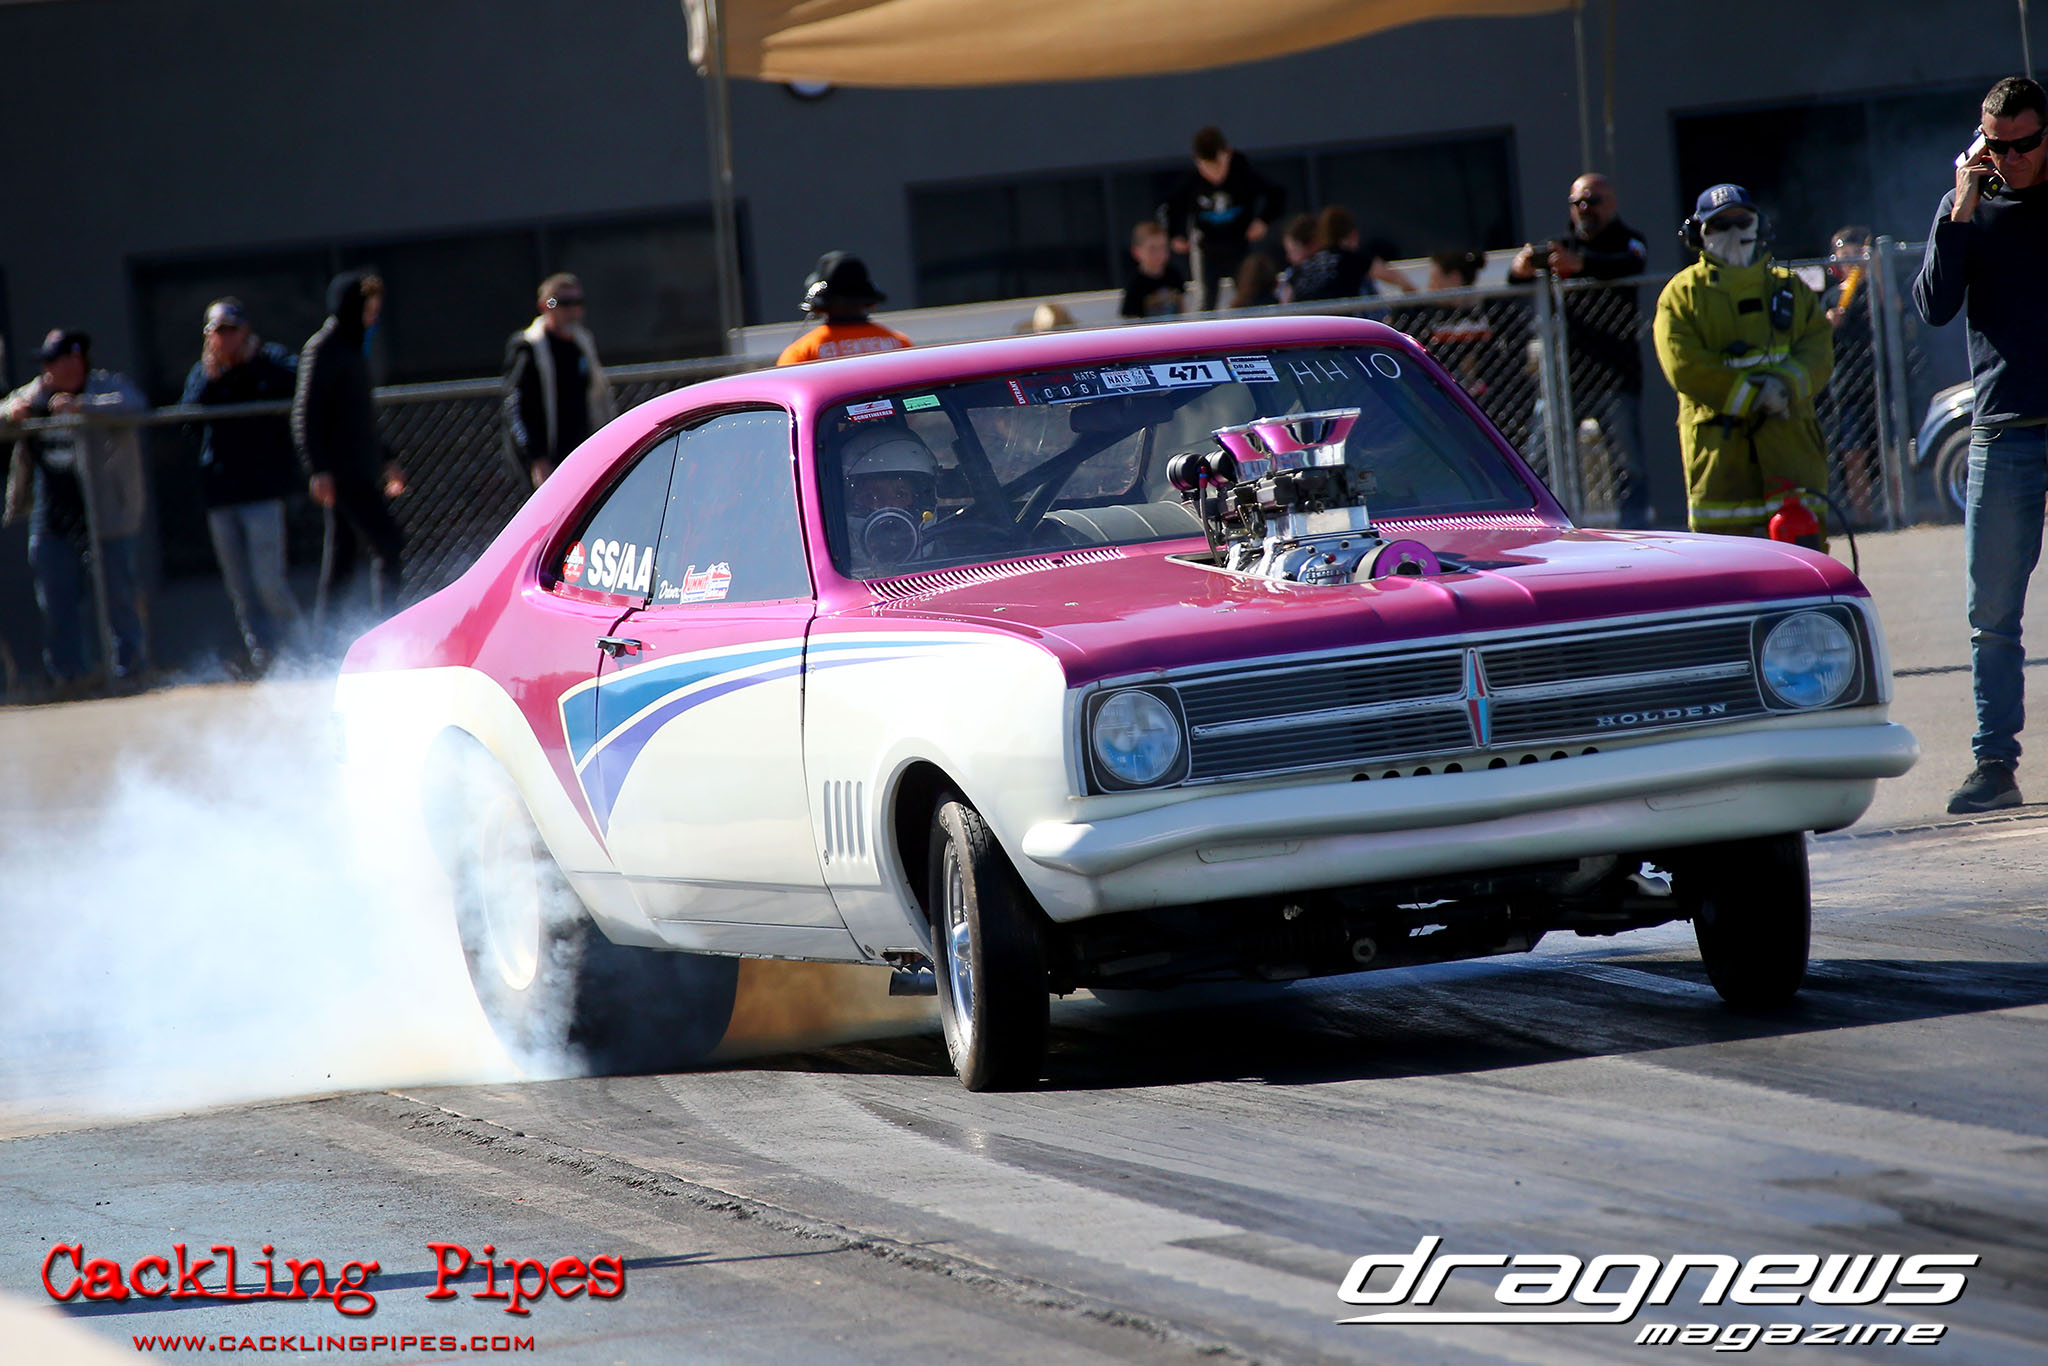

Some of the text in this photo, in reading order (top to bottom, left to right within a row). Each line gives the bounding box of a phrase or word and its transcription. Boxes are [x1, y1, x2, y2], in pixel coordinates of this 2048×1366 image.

[1073, 370, 1097, 382] NATS
[1106, 374, 1131, 384] NATS
[1169, 364, 1213, 381] 471
[1288, 359, 1349, 385] HH
[853, 410, 893, 421] SCRUTINEERED
[587, 538, 653, 593] SS/AA
[682, 569, 709, 593] SUMMIT
[1597, 703, 1727, 728] HOLDEN
